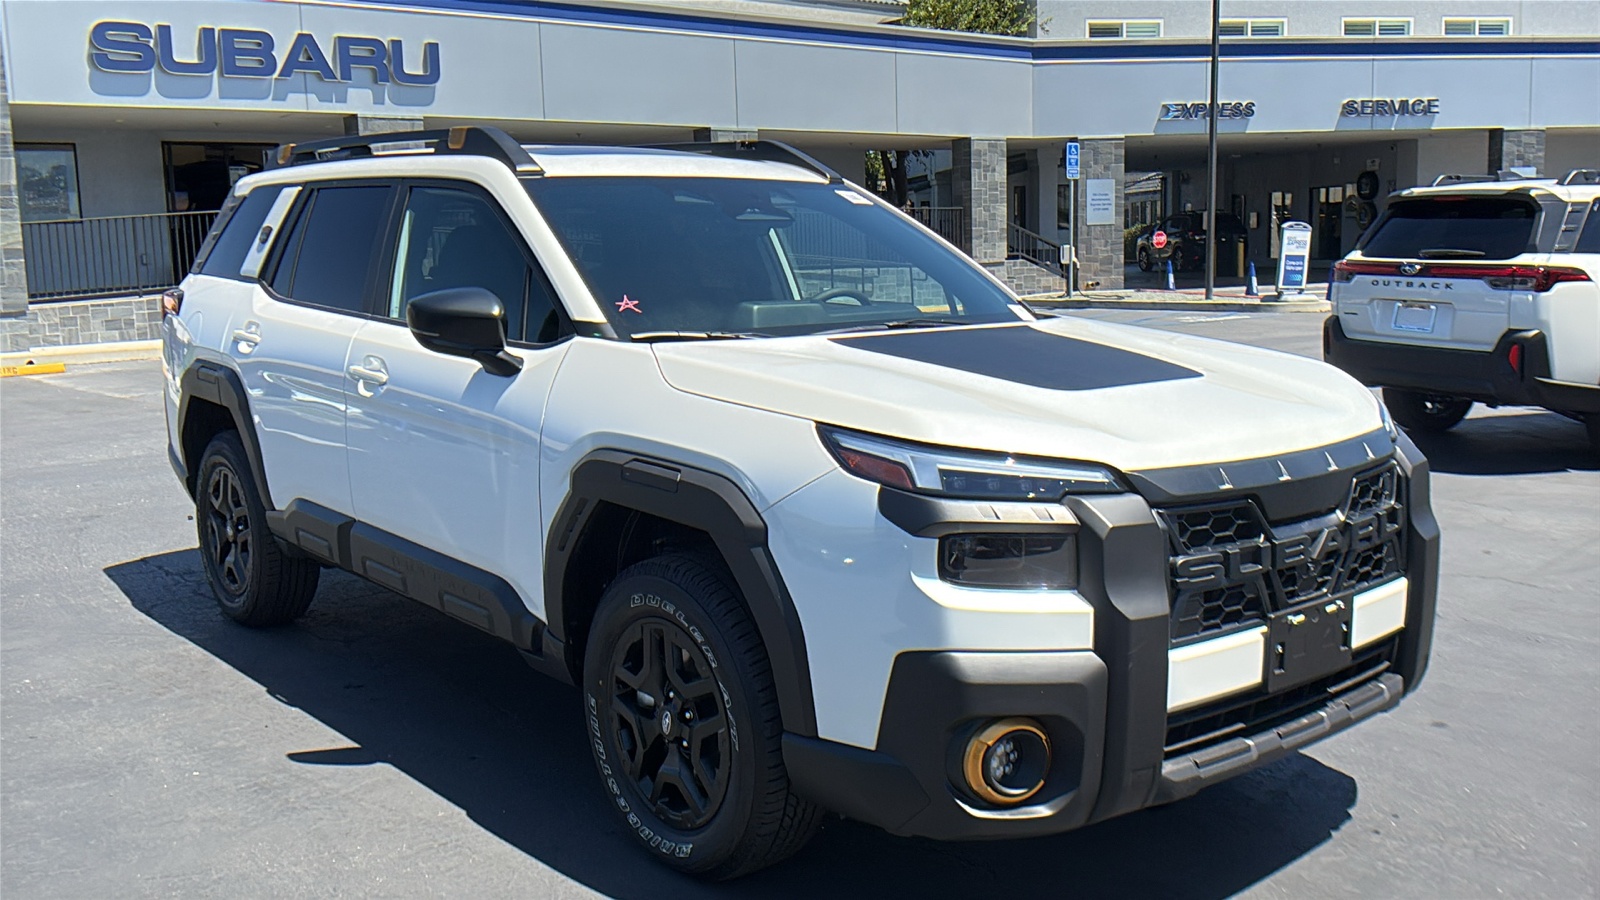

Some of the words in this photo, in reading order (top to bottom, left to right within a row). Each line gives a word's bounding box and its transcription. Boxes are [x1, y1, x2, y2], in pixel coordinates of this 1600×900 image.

[90, 20, 441, 87] SUBARU
[1344, 98, 1440, 116] SERVICE
[1371, 279, 1454, 290] OUTBACK
[0, 367, 18, 375] ING
[1176, 503, 1404, 585] SUBARU
[629, 593, 719, 669] DUELER
[587, 693, 694, 859] BRIDGESTONE
